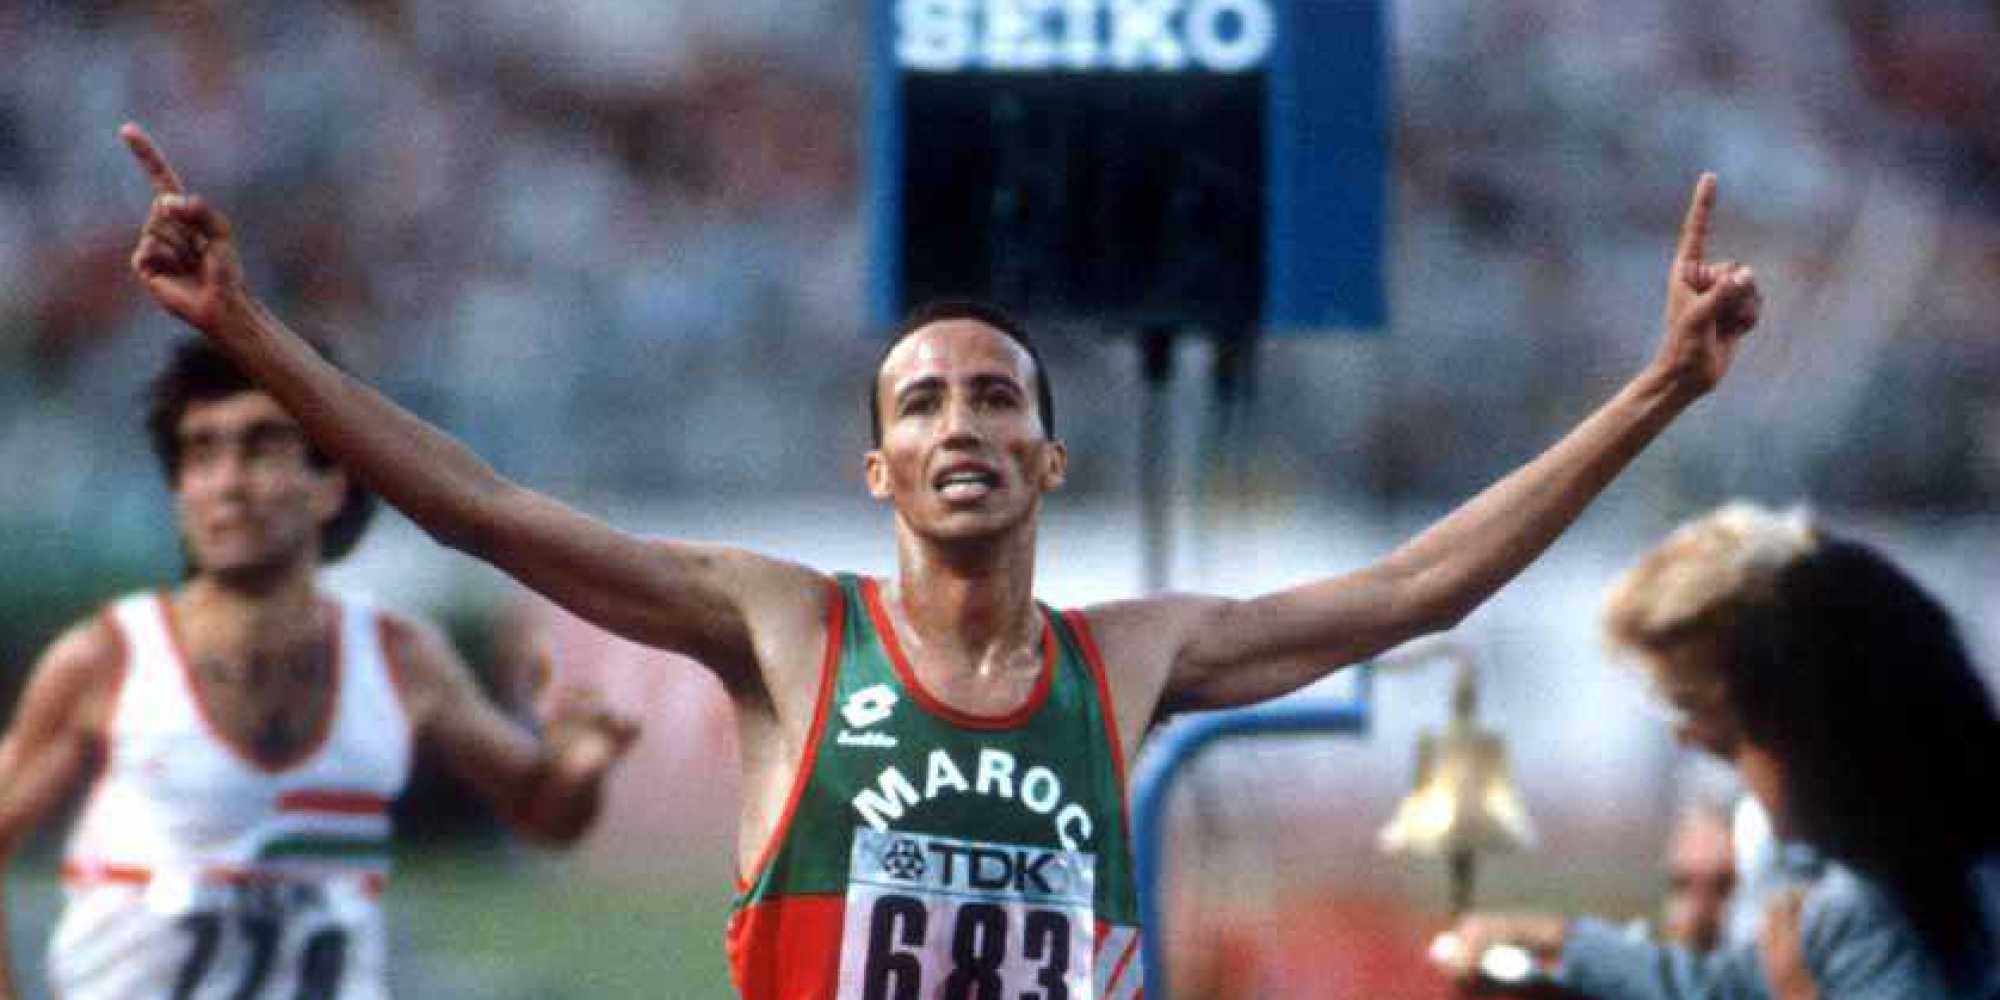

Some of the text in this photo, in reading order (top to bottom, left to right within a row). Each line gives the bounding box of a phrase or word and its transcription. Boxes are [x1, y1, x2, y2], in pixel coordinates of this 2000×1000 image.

[896, 0, 1275, 71] SEIKO
[851, 747, 1092, 850] MAROC
[927, 842, 1054, 894] TDK
[862, 895, 1070, 1000] 683
